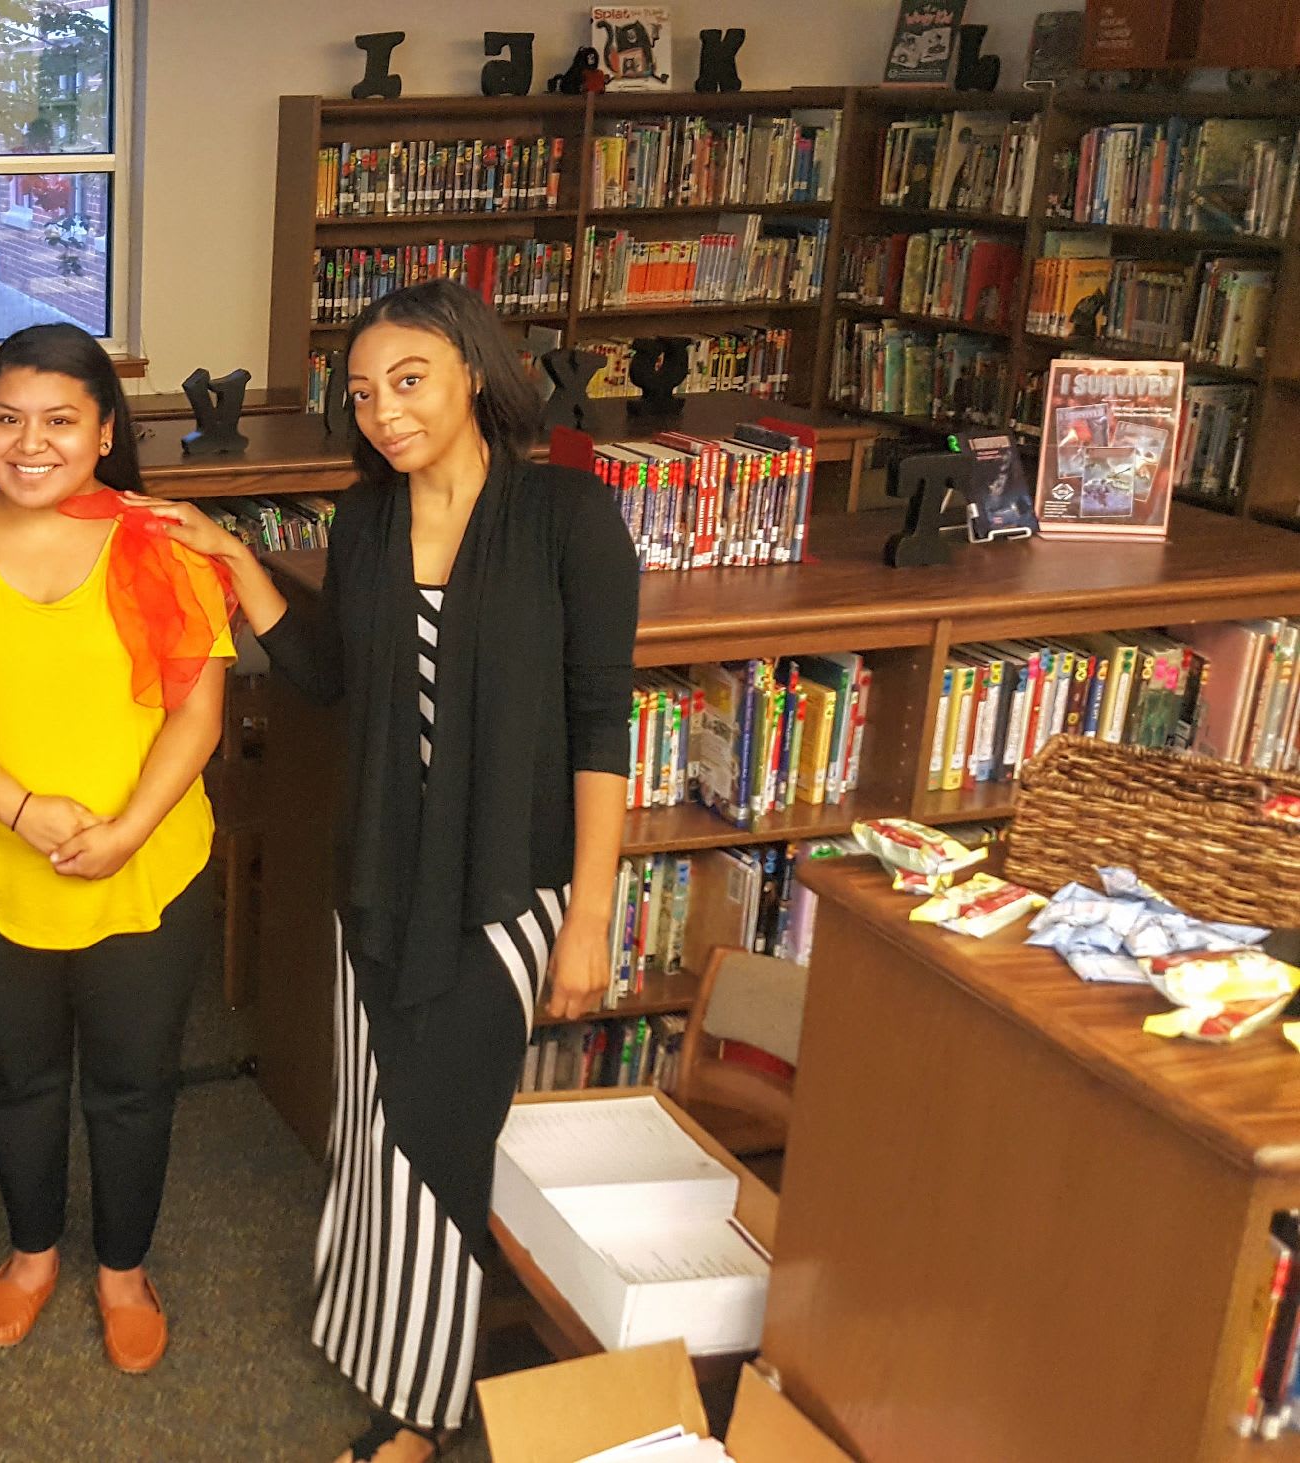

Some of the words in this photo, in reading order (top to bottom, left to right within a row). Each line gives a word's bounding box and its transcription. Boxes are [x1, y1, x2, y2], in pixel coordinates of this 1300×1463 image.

[351, 31, 406, 99] I
[481, 31, 535, 97] J
[695, 28, 746, 93] K
[1059, 373, 1071, 396] I
